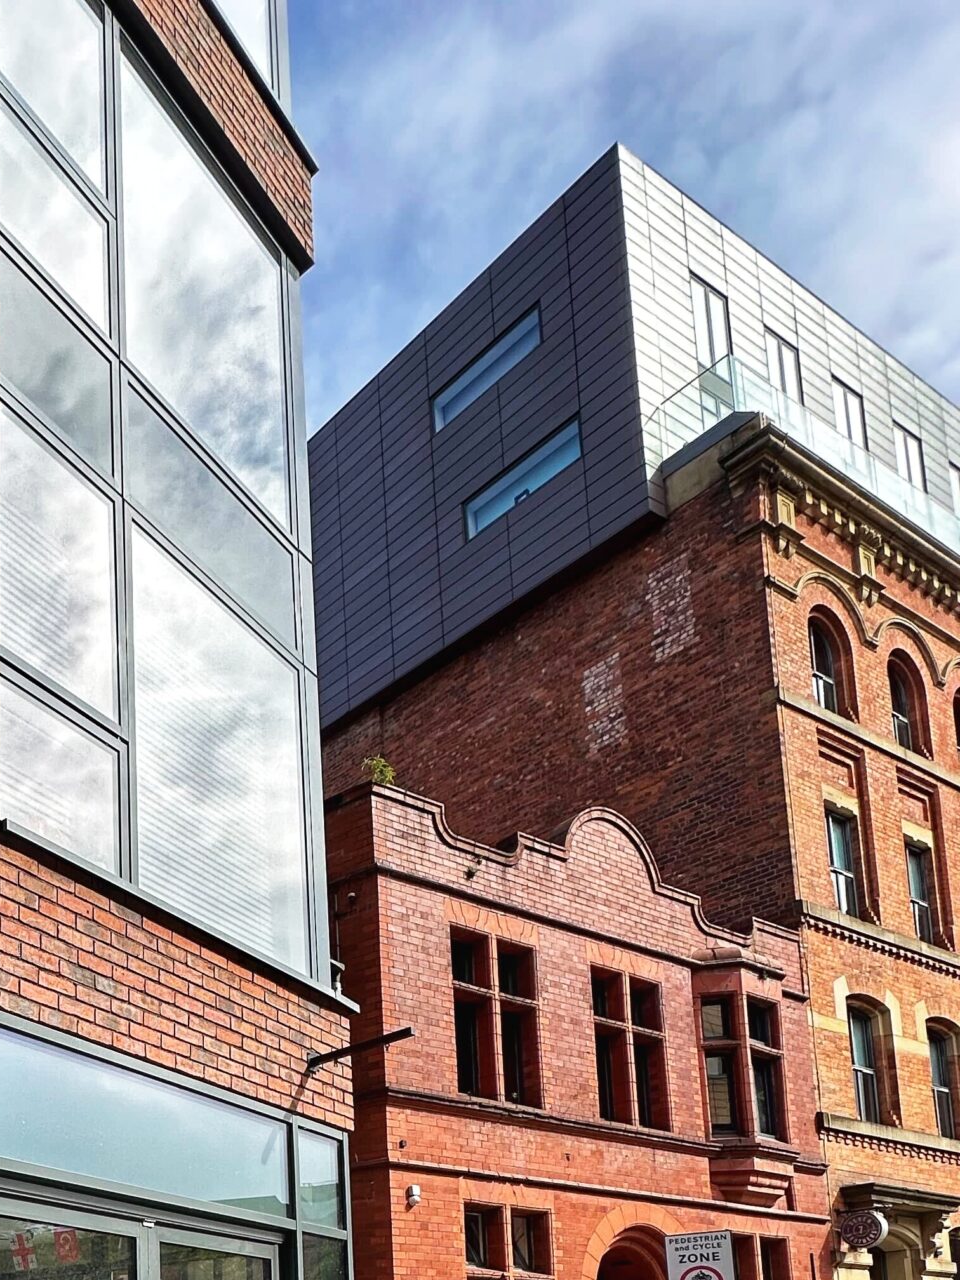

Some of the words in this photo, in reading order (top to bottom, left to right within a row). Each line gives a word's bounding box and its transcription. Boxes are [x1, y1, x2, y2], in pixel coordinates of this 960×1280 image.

[669, 1234, 727, 1245] PEDESTRIAN
[692, 1242, 723, 1251] CYCLE
[678, 1252, 721, 1264] ZONE
